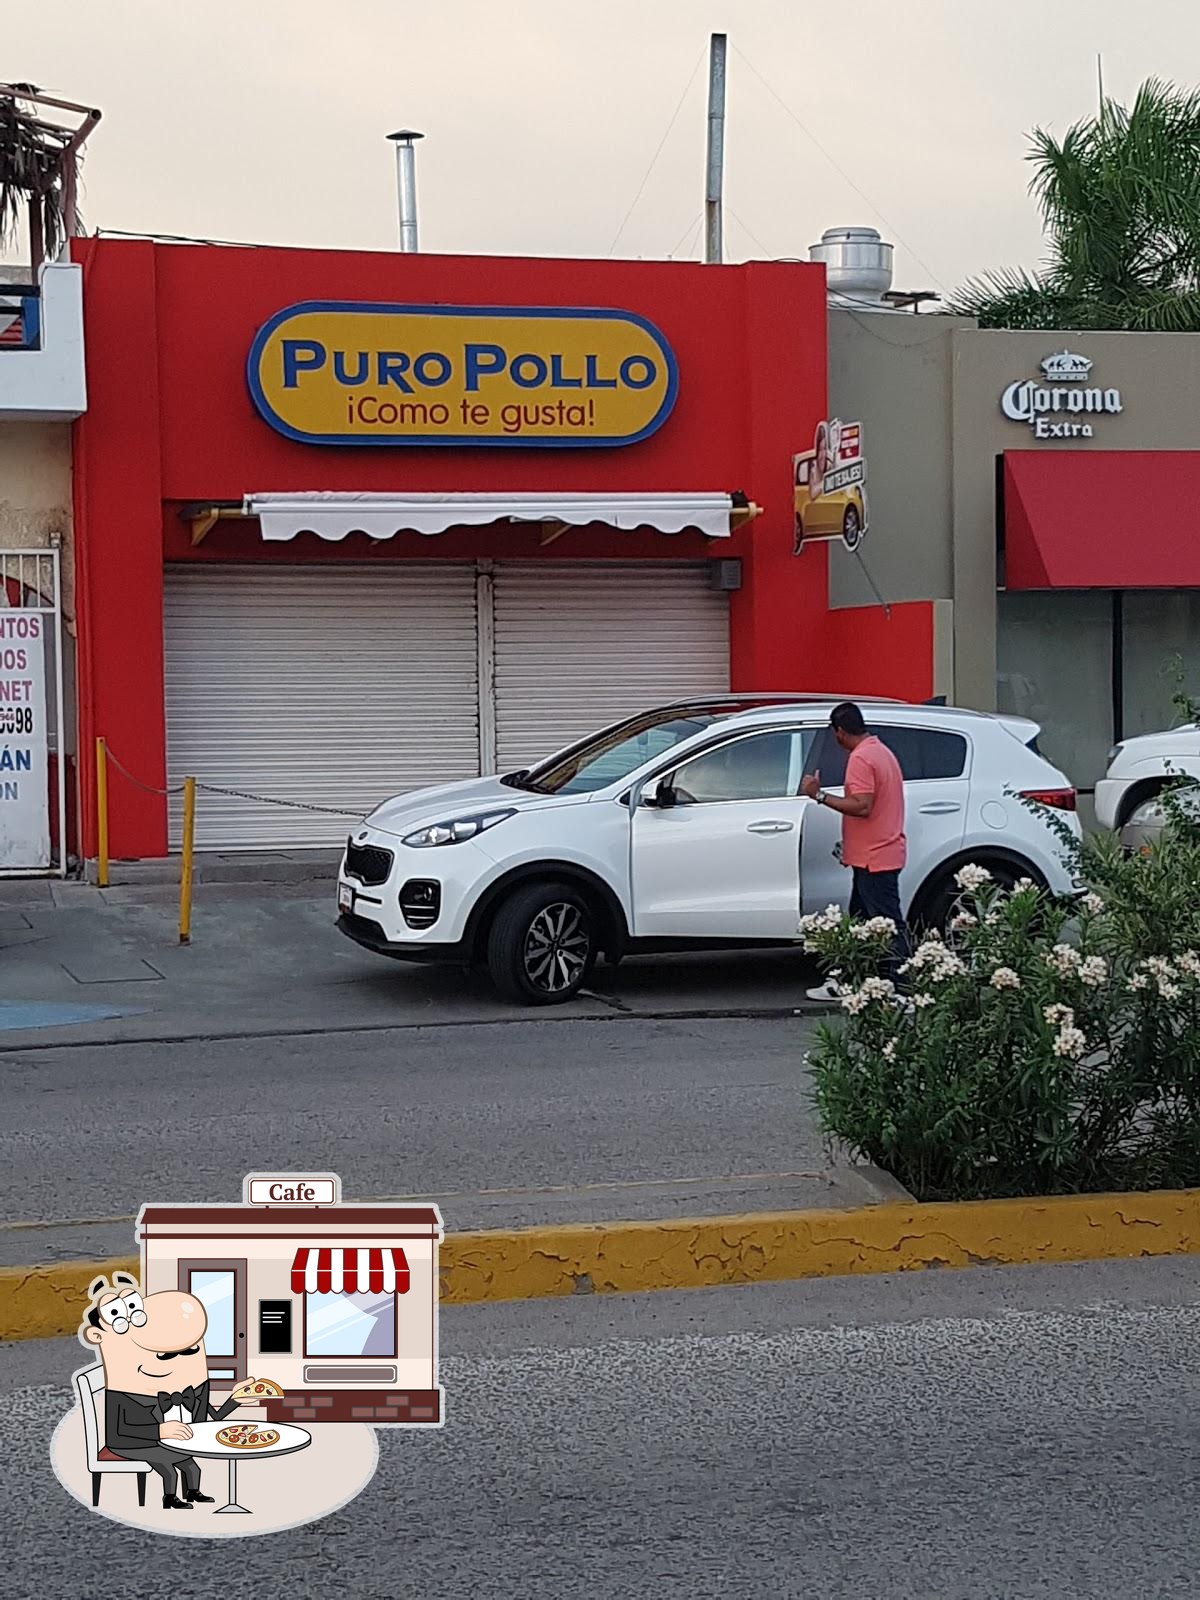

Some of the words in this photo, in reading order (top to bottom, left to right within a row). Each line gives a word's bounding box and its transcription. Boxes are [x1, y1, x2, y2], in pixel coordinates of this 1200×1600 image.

[282, 339, 453, 394] PURO
[464, 343, 658, 392] POLLO
[460, 398, 490, 426] te
[501, 398, 596, 433] gusta!
[1001, 379, 1124, 424] Corona
[1035, 417, 1094, 438] Extra
